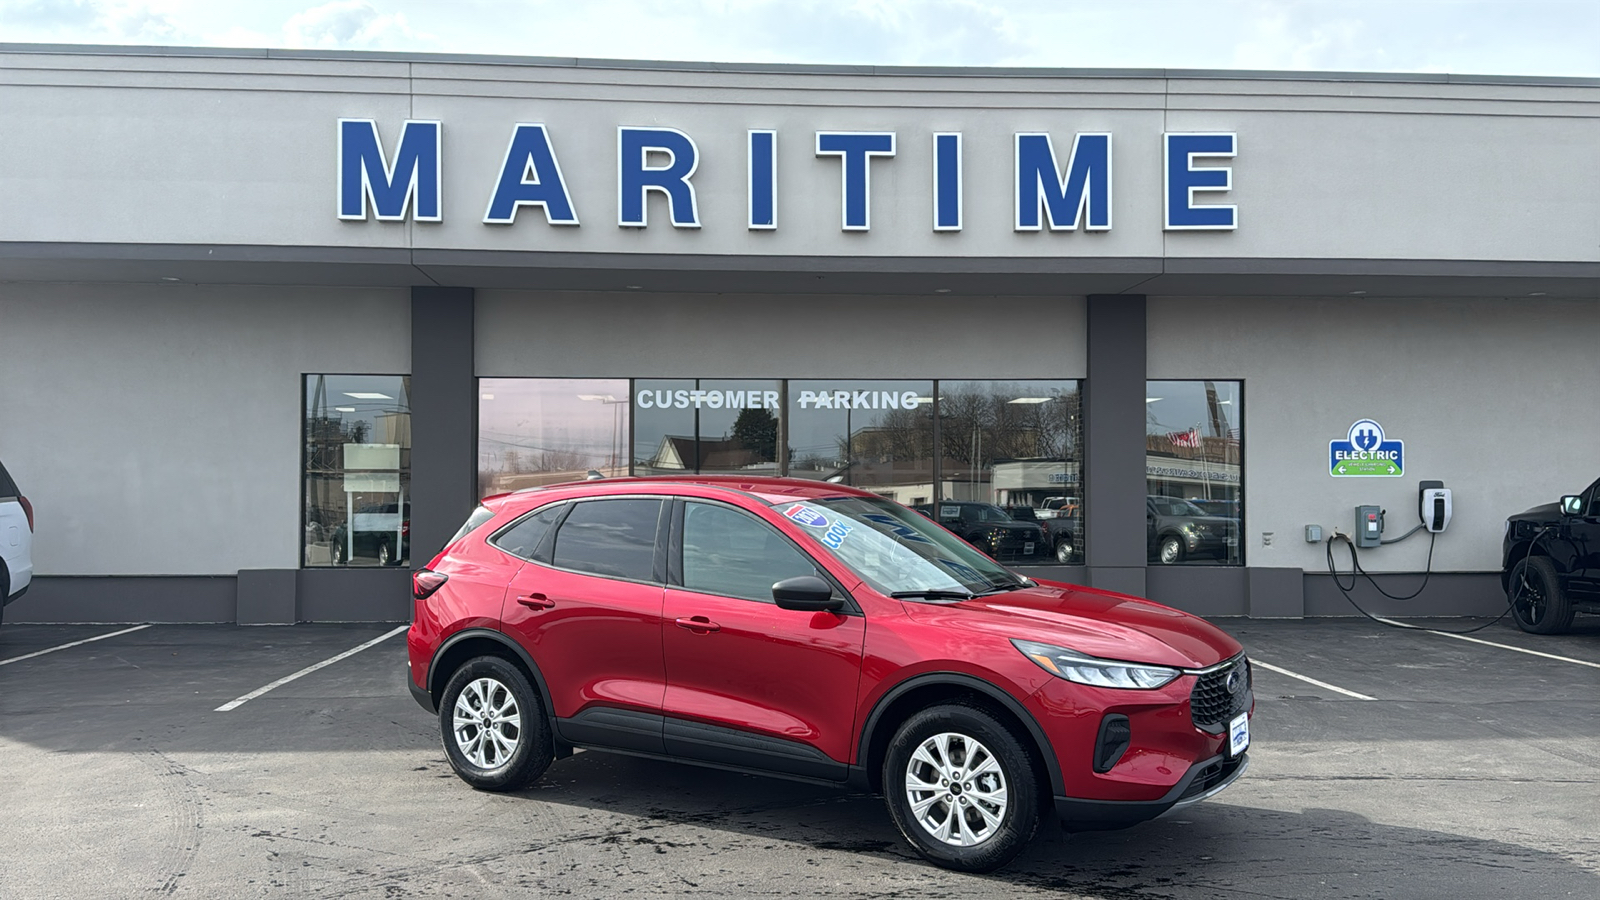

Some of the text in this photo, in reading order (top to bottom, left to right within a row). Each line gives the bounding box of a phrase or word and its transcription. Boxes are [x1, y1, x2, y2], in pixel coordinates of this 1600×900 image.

[337, 117, 1238, 232] MARITIME
[637, 389, 920, 410] CUSTOMER PARKING
[1335, 450, 1398, 460] ELECTRIC
[820, 519, 853, 550] LOOK
